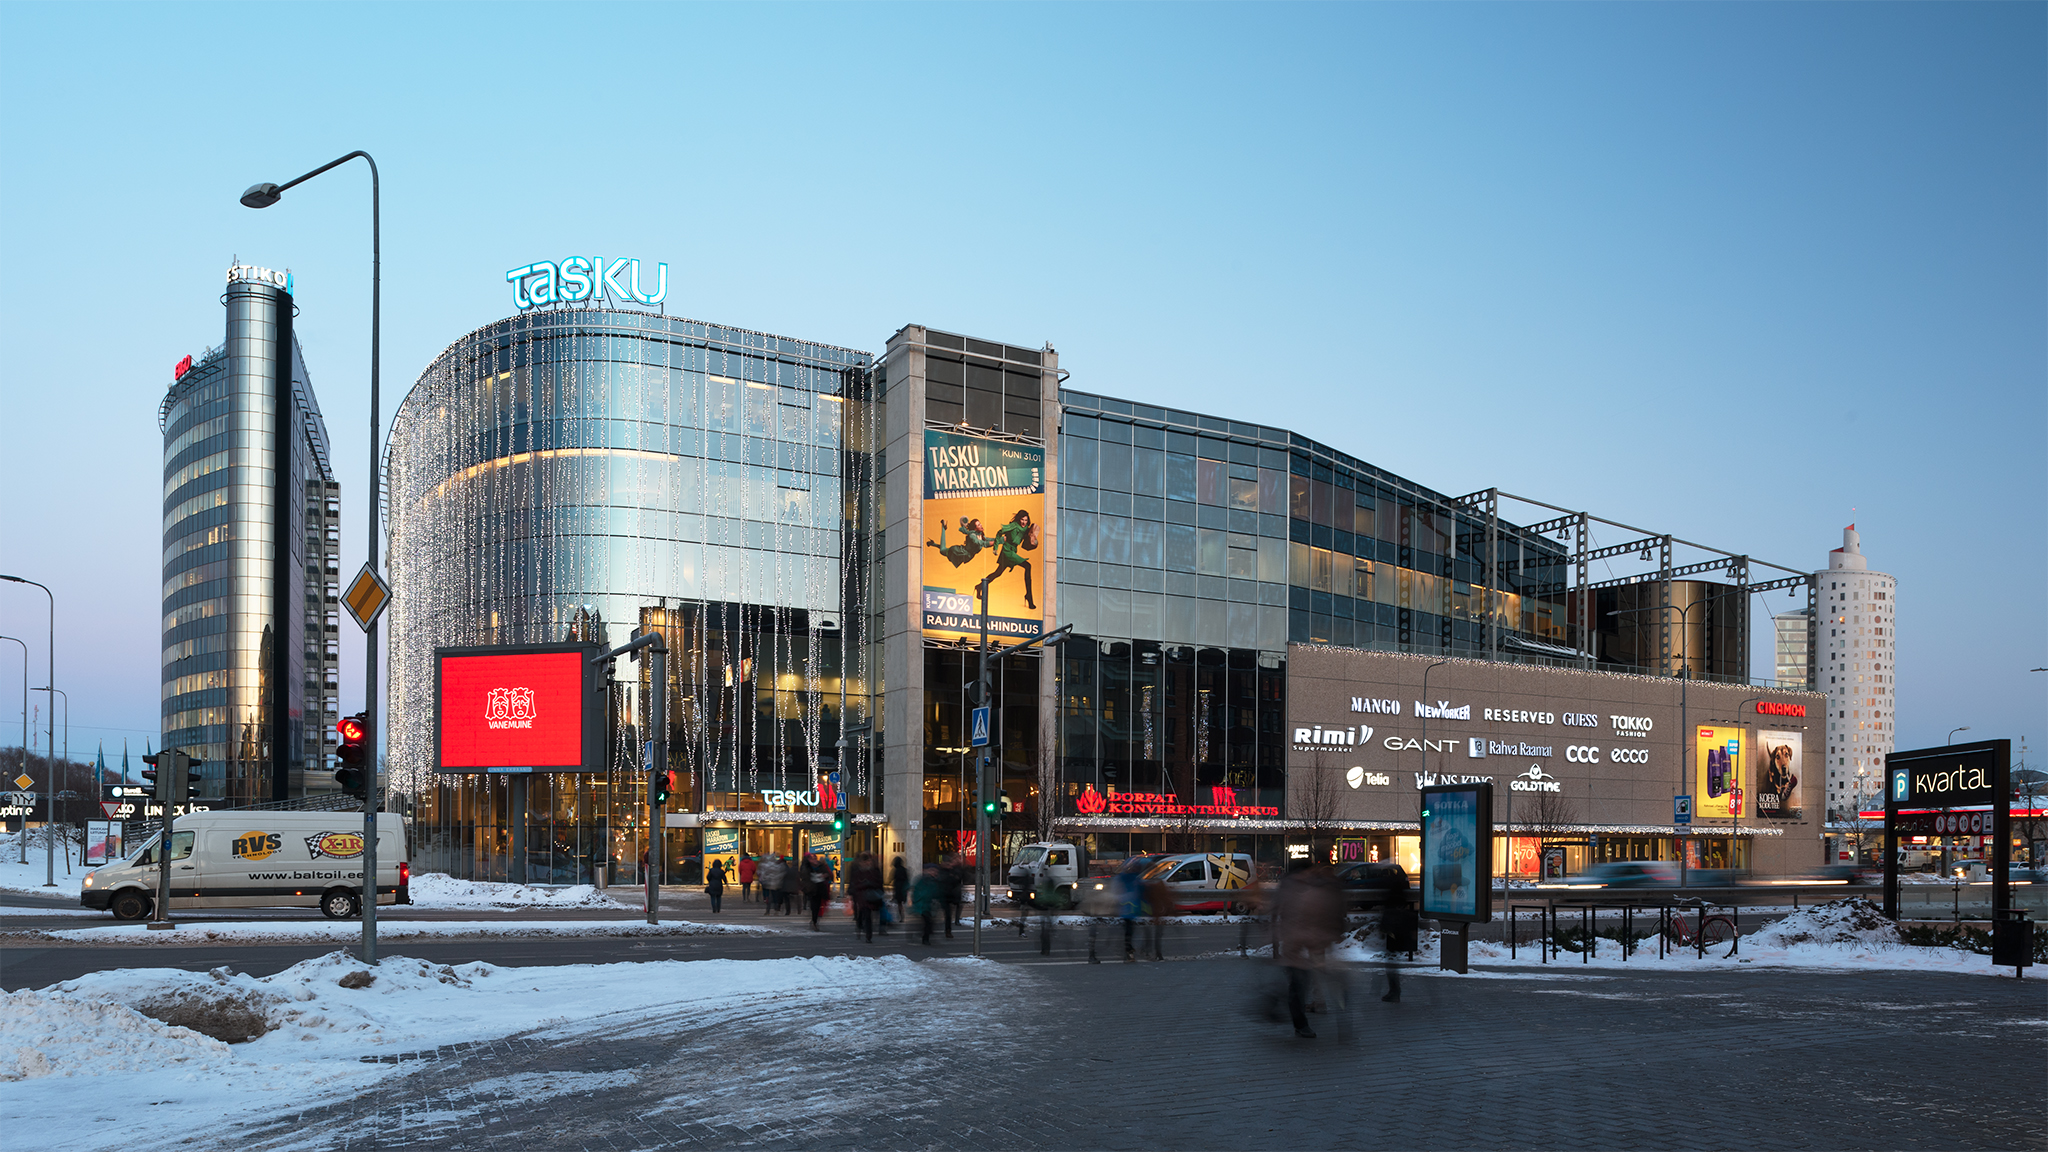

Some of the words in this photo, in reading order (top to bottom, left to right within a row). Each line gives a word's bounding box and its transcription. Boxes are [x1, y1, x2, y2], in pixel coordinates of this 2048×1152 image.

[226, 265, 287, 286] ESTIKO
[929, 445, 979, 468] TASKU
[1002, 449, 1022, 459] KUNI
[1023, 452, 1041, 462] 31.01
[933, 465, 1009, 490] MARATON
[931, 595, 971, 612] -70%
[926, 614, 958, 627] RAJU
[1351, 697, 1400, 715] MANGO
[1756, 701, 1806, 717] CINAMON
[1484, 708, 1555, 725] RESERVED
[1562, 712, 1598, 727] GUESS
[488, 720, 532, 729] VANEMUINE
[1616, 730, 1646, 738] FASHION
[1293, 745, 1352, 753] Supermarket
[1384, 736, 1460, 753] GANT
[1489, 740, 1517, 756] Rahva
[1519, 742, 1552, 757] Raamat
[1566, 745, 1599, 764] CCC
[1611, 748, 1649, 764] ecco
[1365, 773, 1389, 786] Telia
[1109, 791, 1177, 803] DORPAT
[144, 805, 185, 816] LINX
[1109, 803, 1279, 816] KONVERENTSIKESKUS
[232, 833, 282, 855] RVS
[325, 838, 363, 849] X-1R
[232, 849, 283, 860] TECHNOLOGY
[248, 871, 364, 880] www.baltoil.ee
